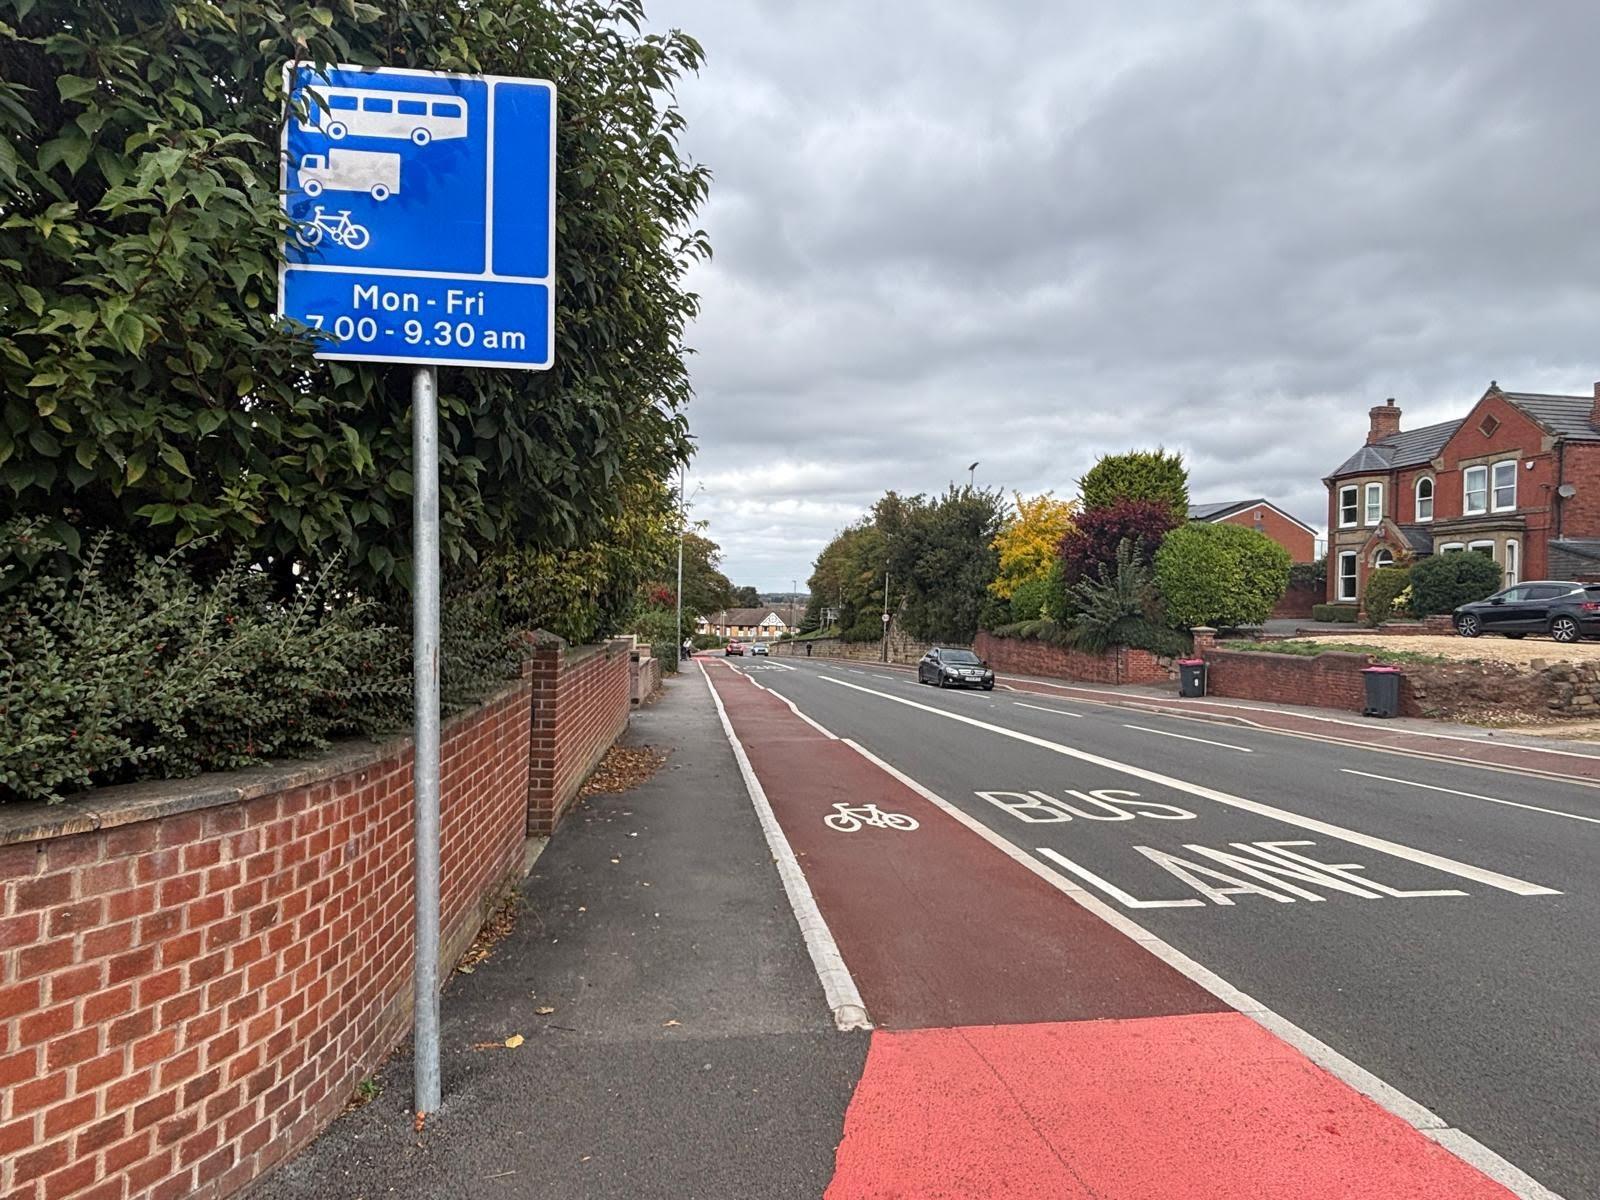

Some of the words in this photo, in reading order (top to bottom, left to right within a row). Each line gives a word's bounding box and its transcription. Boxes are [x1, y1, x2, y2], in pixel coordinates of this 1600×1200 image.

[352, 284, 419, 312] Mon
[446, 290, 485, 316] Fri
[403, 319, 475, 347] 9.30
[482, 330, 526, 350] am
[974, 789, 1197, 823] BUS
[1036, 840, 1470, 908] LANE
